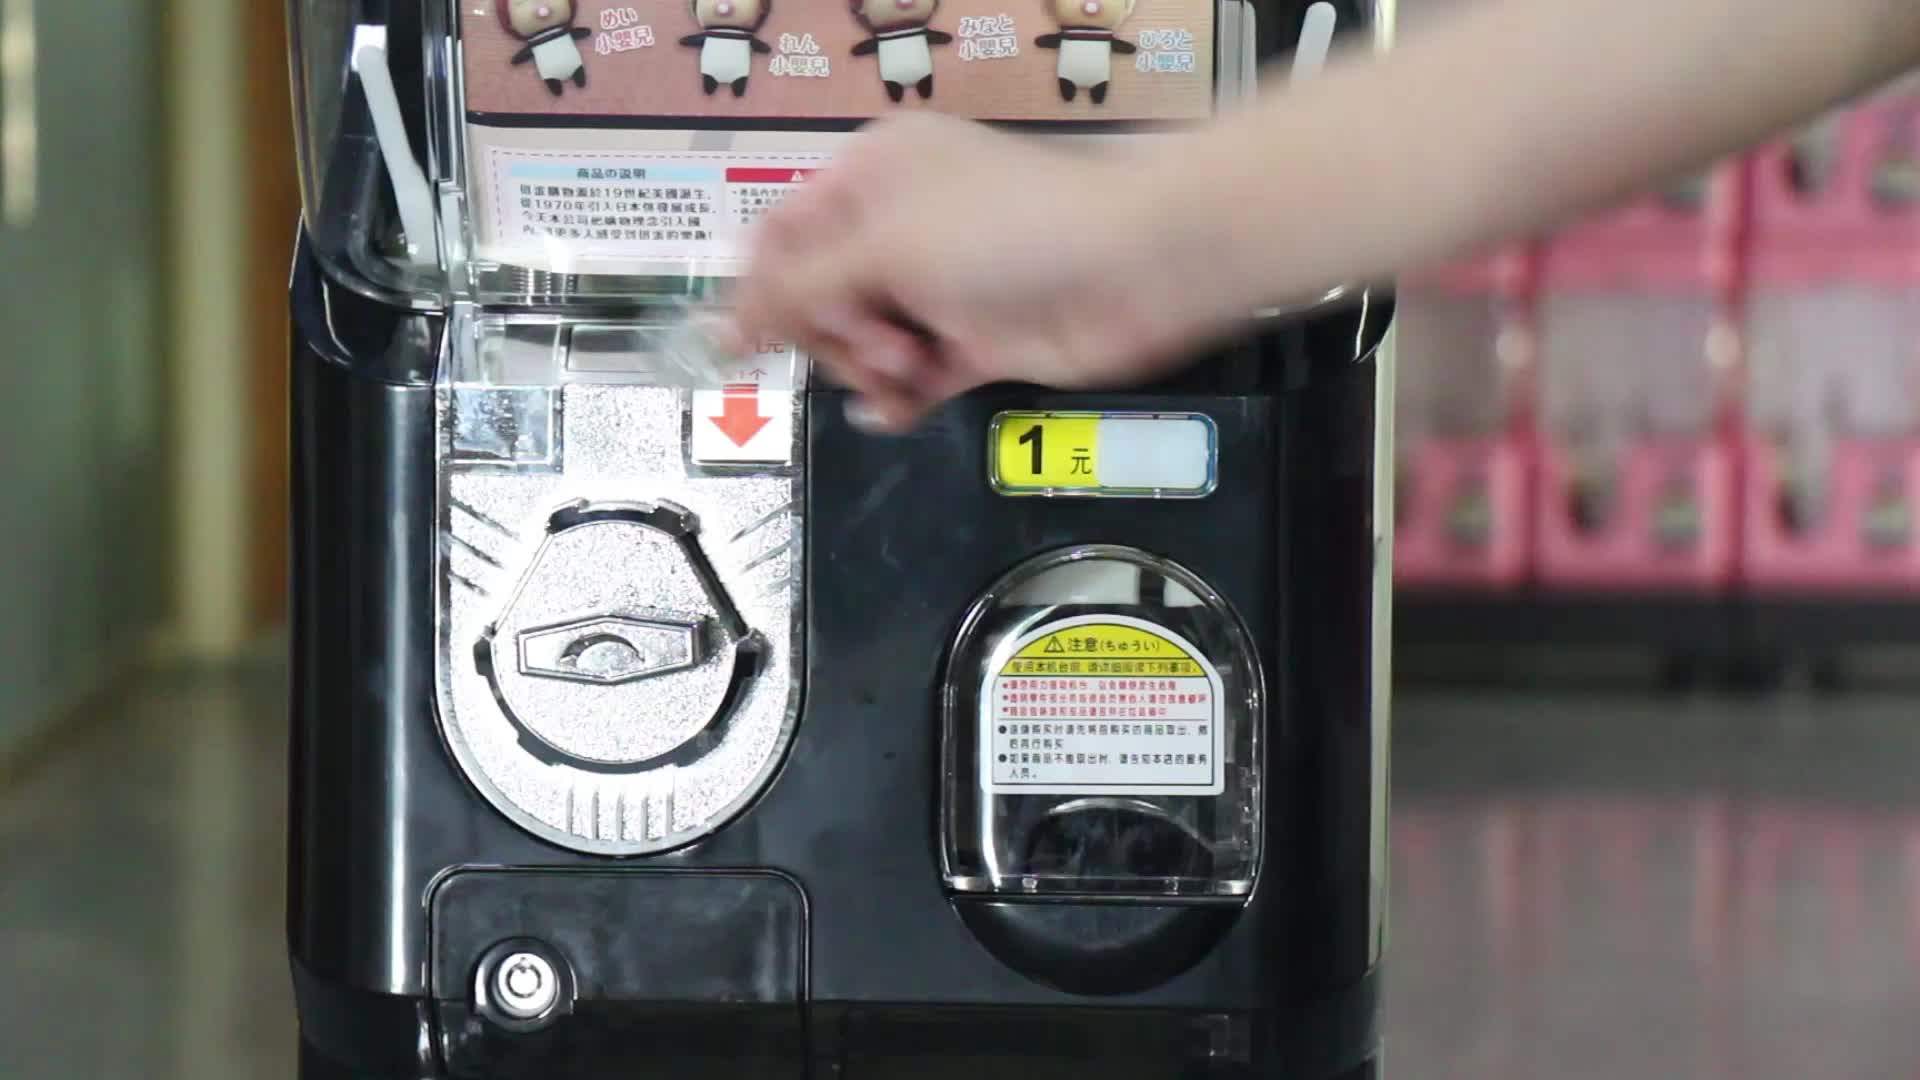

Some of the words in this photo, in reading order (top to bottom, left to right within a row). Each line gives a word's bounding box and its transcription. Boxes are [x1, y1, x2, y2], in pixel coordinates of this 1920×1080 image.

[601, 8, 638, 29] めい
[959, 15, 1016, 37] みなと
[780, 33, 819, 54] れん
[1139, 30, 1193, 50] ひろと
[1018, 424, 1044, 475] 1
[1070, 447, 1093, 475] 元
